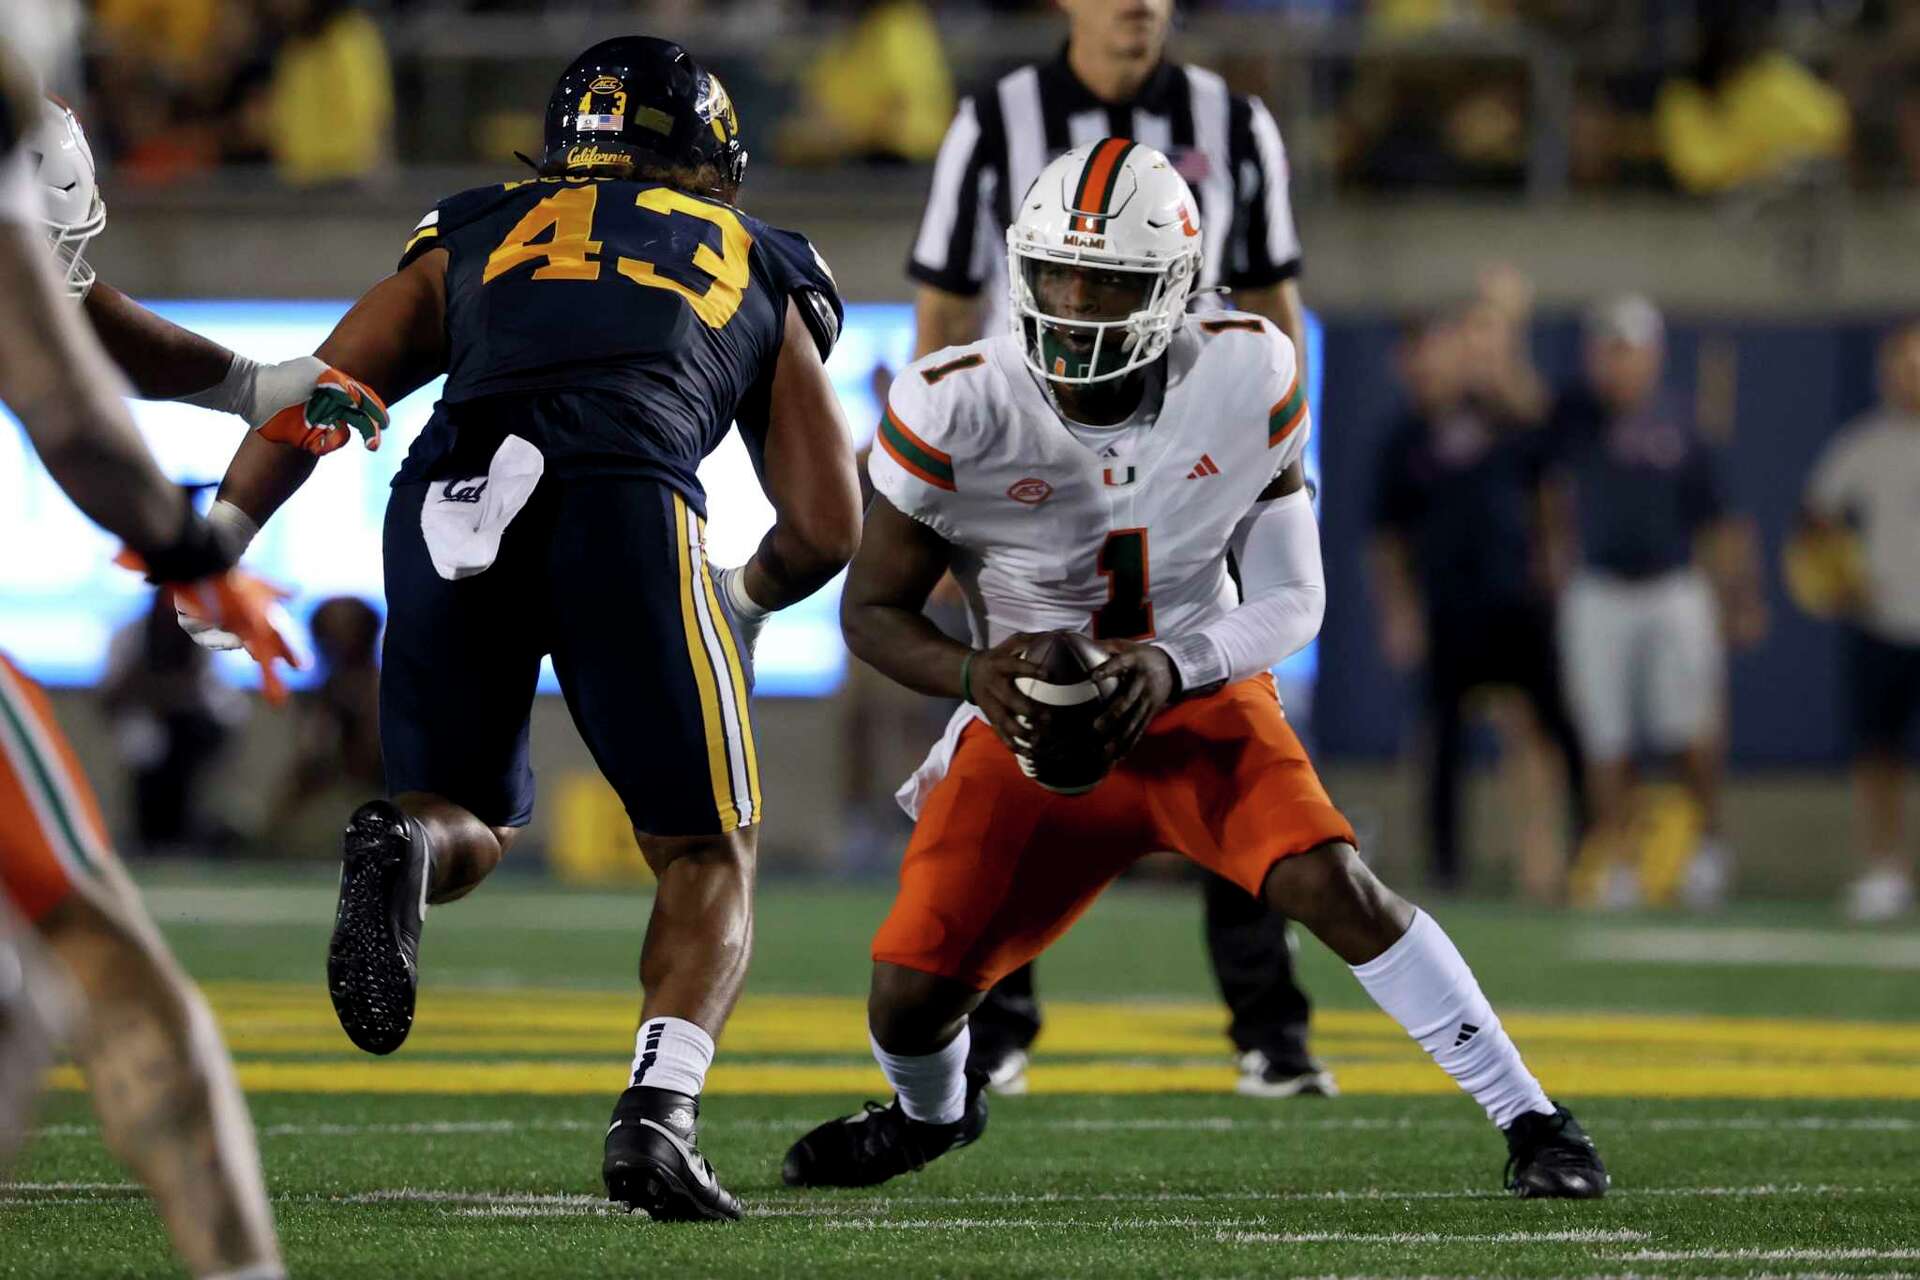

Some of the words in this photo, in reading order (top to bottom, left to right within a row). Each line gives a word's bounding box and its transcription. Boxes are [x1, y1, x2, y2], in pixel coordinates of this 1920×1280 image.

[567, 145, 634, 168] California
[1063, 234, 1106, 249] MIAMI
[483, 184, 753, 329] 43
[1201, 319, 1266, 336] 1
[920, 353, 986, 386] 1
[1103, 466, 1135, 486] U
[438, 478, 488, 503] Cal
[1091, 527, 1156, 642] 1
